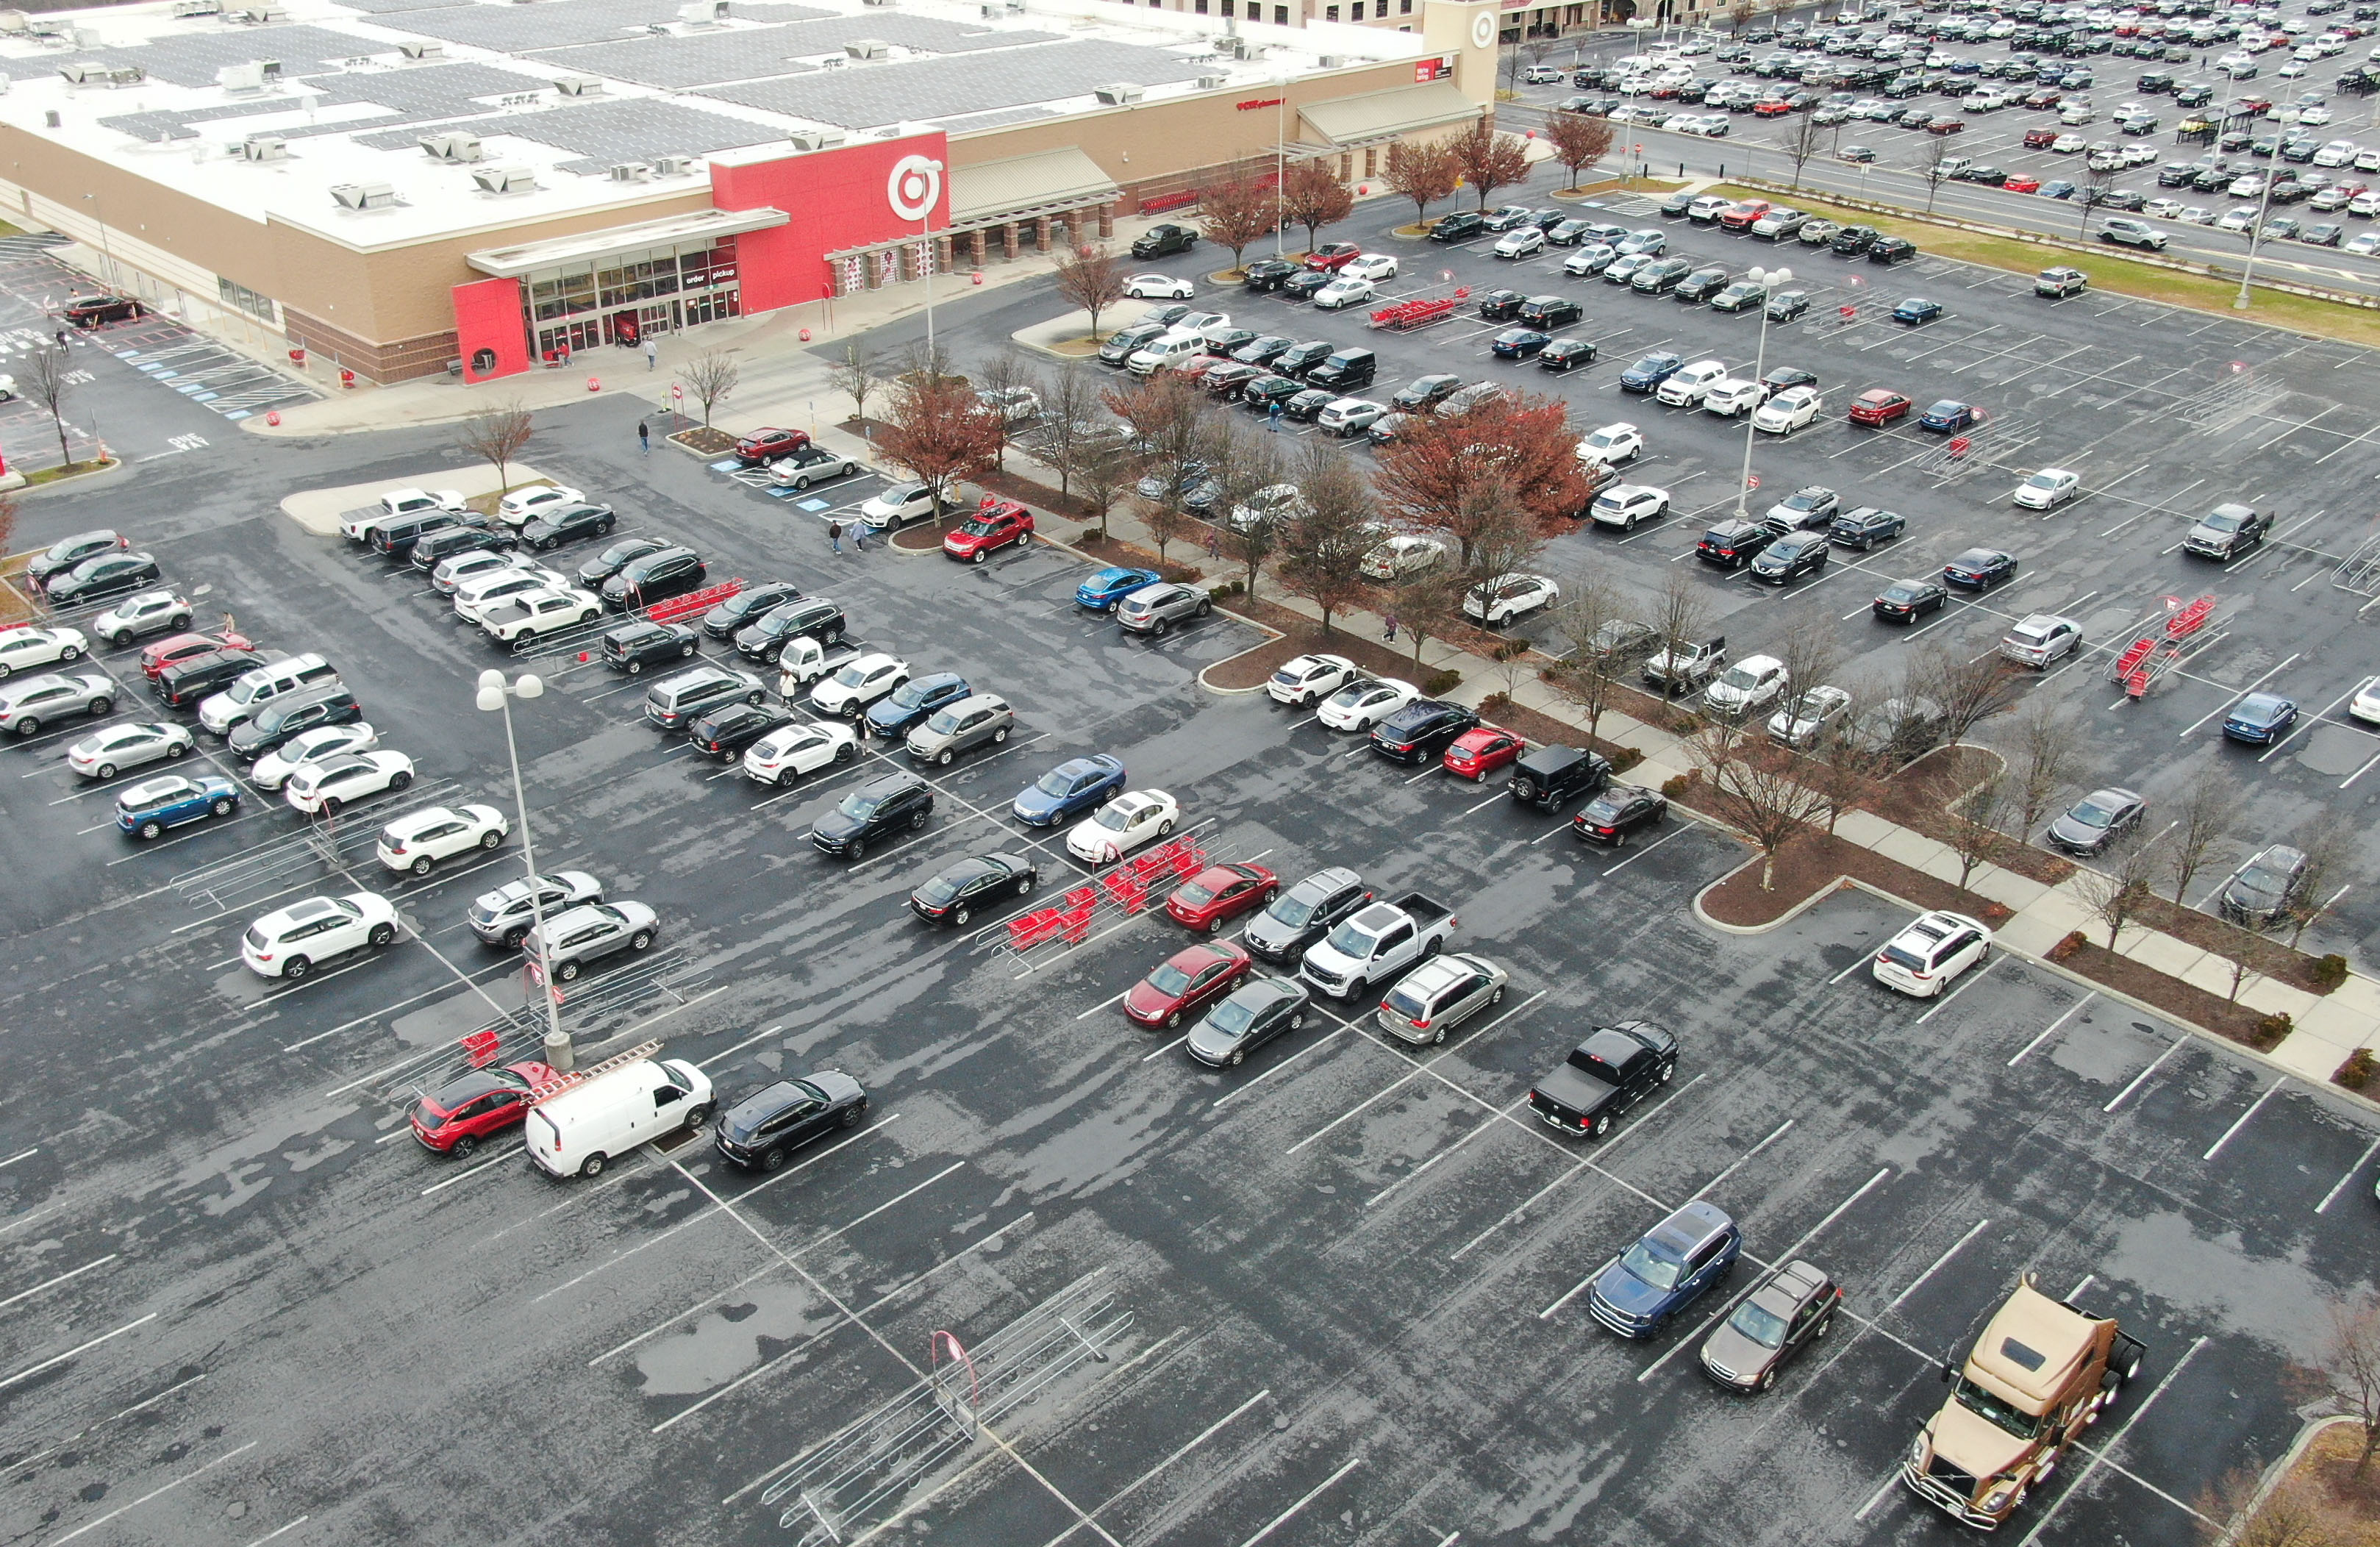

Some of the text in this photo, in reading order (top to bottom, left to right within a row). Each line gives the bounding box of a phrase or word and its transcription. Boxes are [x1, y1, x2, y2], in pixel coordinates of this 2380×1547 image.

[687, 269, 735, 284] order pickup
[168, 432, 198, 446] ONE
[177, 437, 210, 451] WAY
